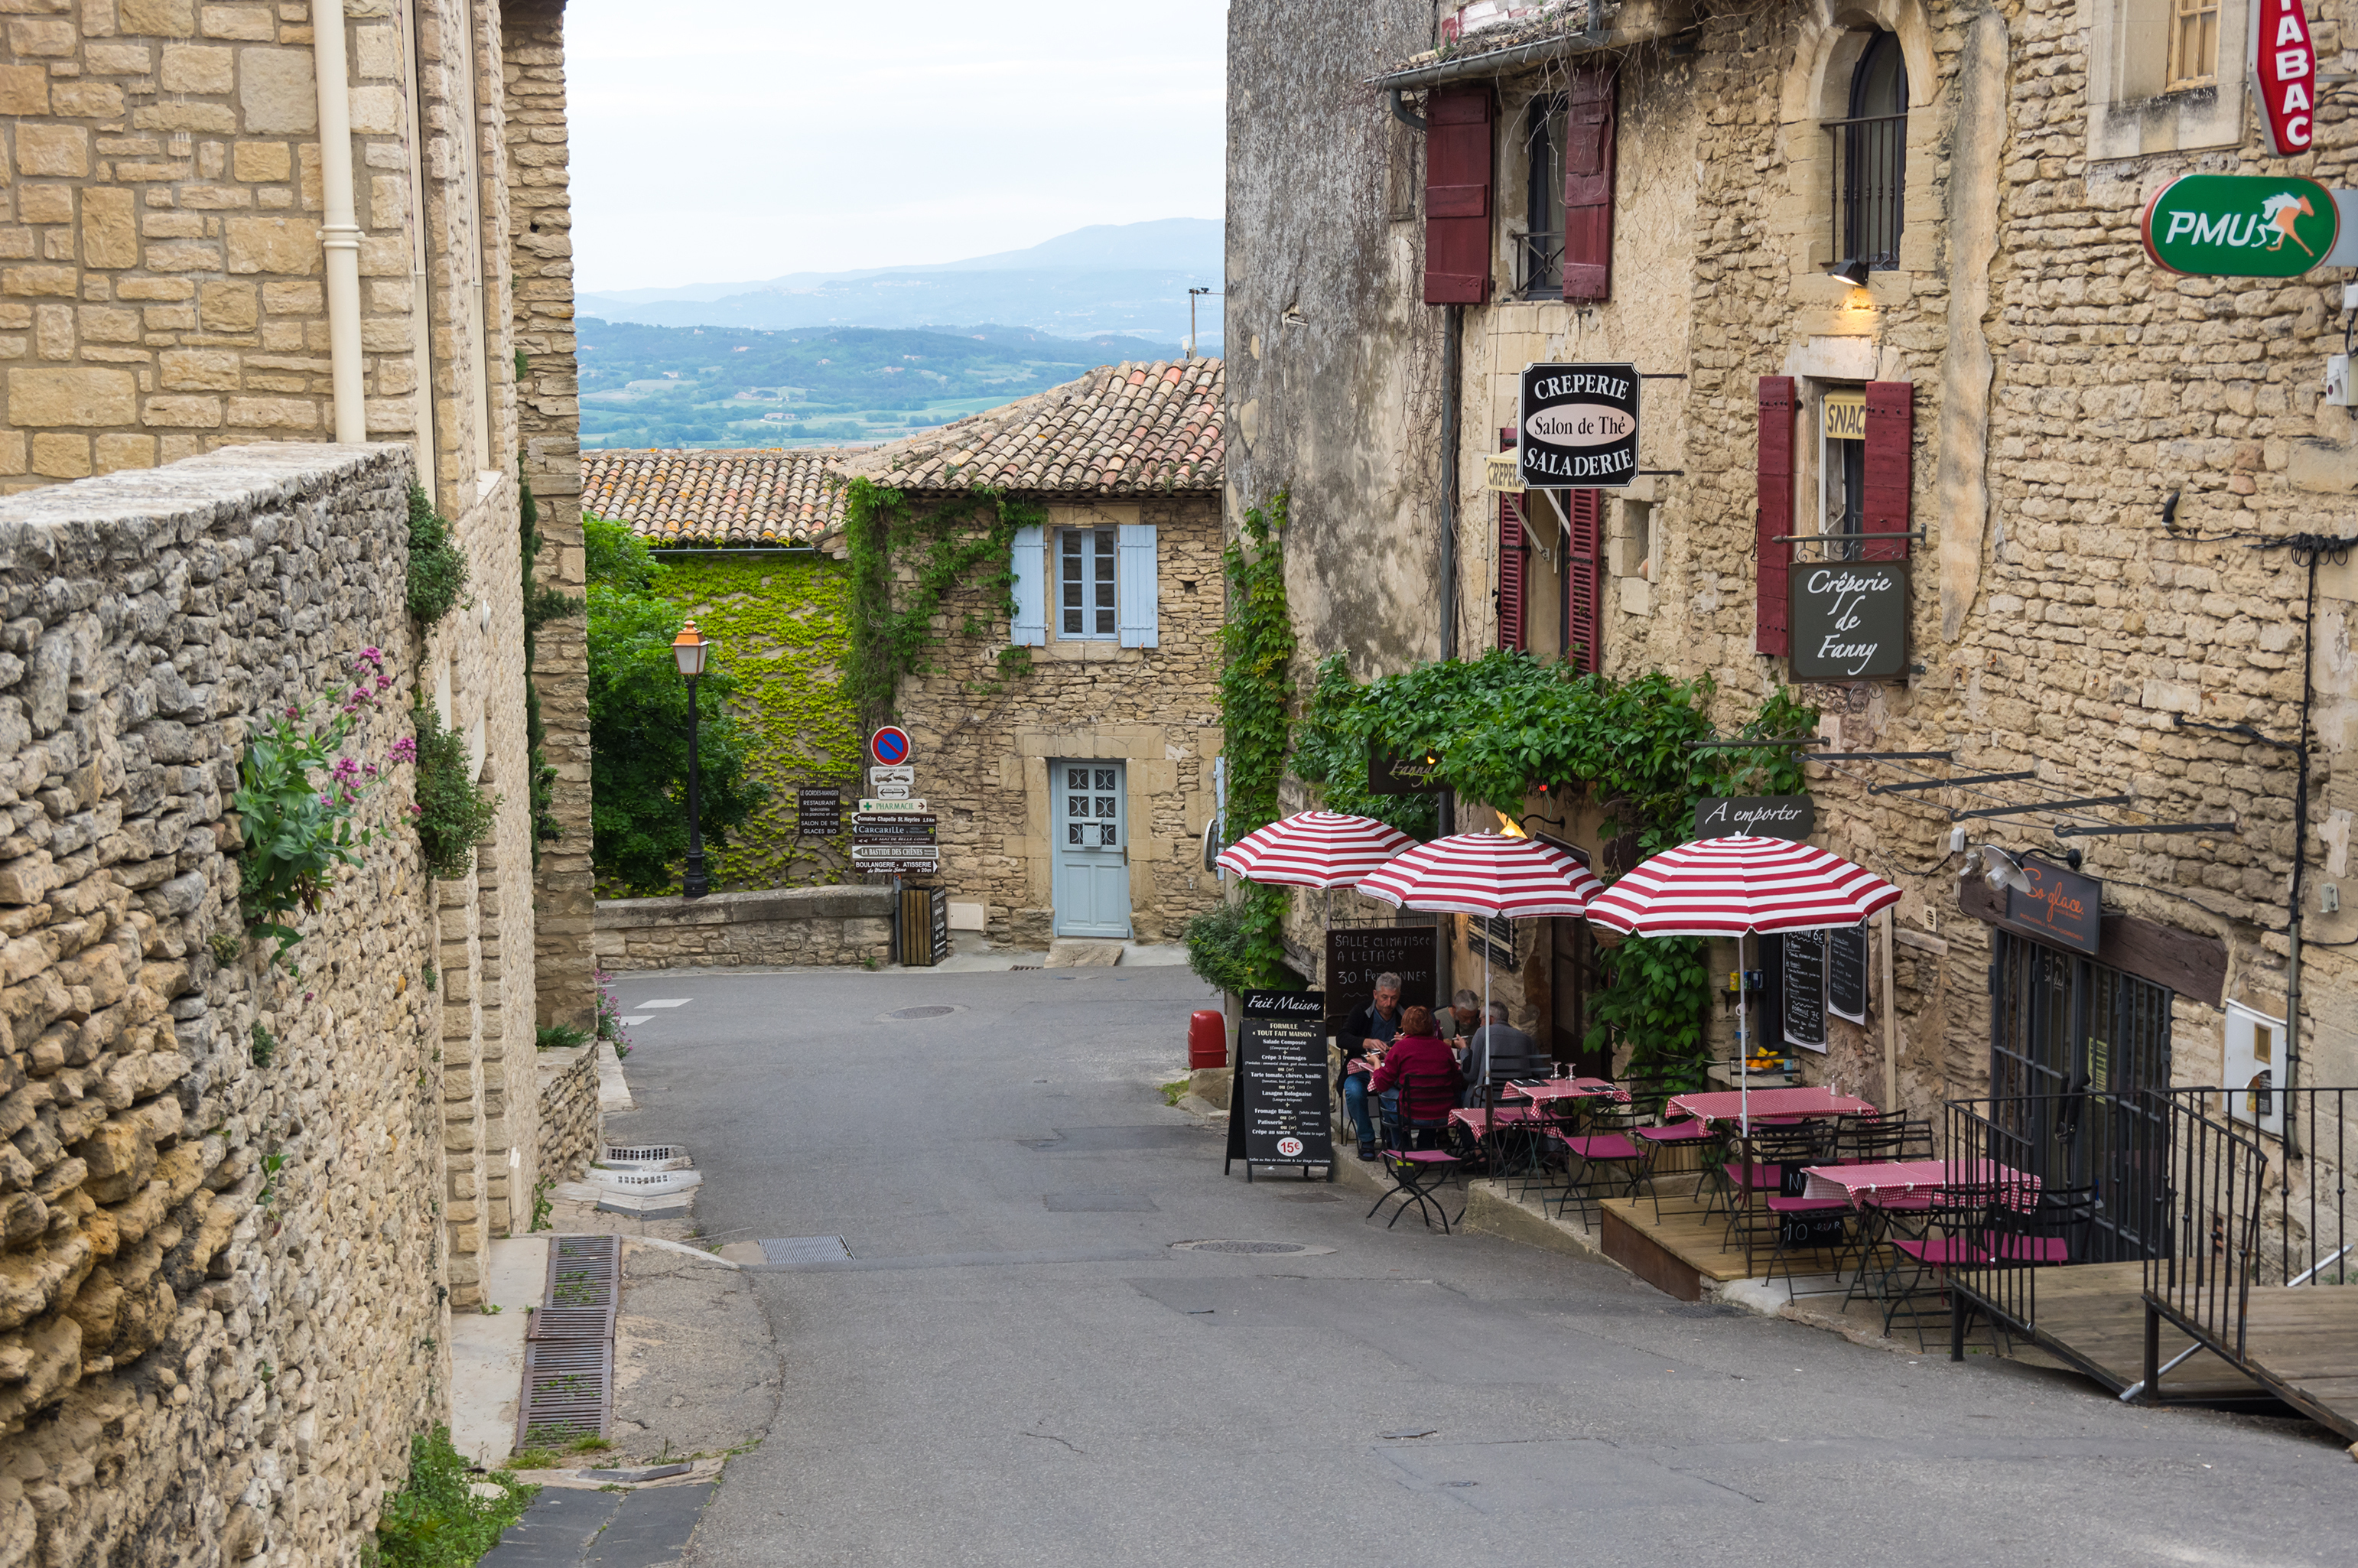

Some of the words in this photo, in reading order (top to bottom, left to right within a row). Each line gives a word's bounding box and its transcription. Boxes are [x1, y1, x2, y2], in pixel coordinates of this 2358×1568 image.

[2165, 211, 2258, 247] PMU
[1534, 374, 1630, 400] CREPERIE
[1534, 416, 1573, 435] Salon
[1578, 417, 1594, 434] de
[1598, 415, 1625, 435] Thé
[1828, 404, 1865, 434] SNAC
[1524, 447, 1634, 477] SALADERIE
[1807, 570, 1892, 616] Crêperie
[1835, 595, 1865, 631] de
[1817, 634, 1878, 675] Fanny
[1705, 802, 1728, 825] A
[1734, 804, 1802, 836] emporter
[903, 847, 923, 855] CHÊNES
[1335, 935, 1368, 948] SALLE
[1337, 951, 1345, 962] A
[1248, 995, 1273, 1008] Fait
[1274, 996, 1321, 1010] Maison
[1280, 1142, 1300, 1153] 15€
